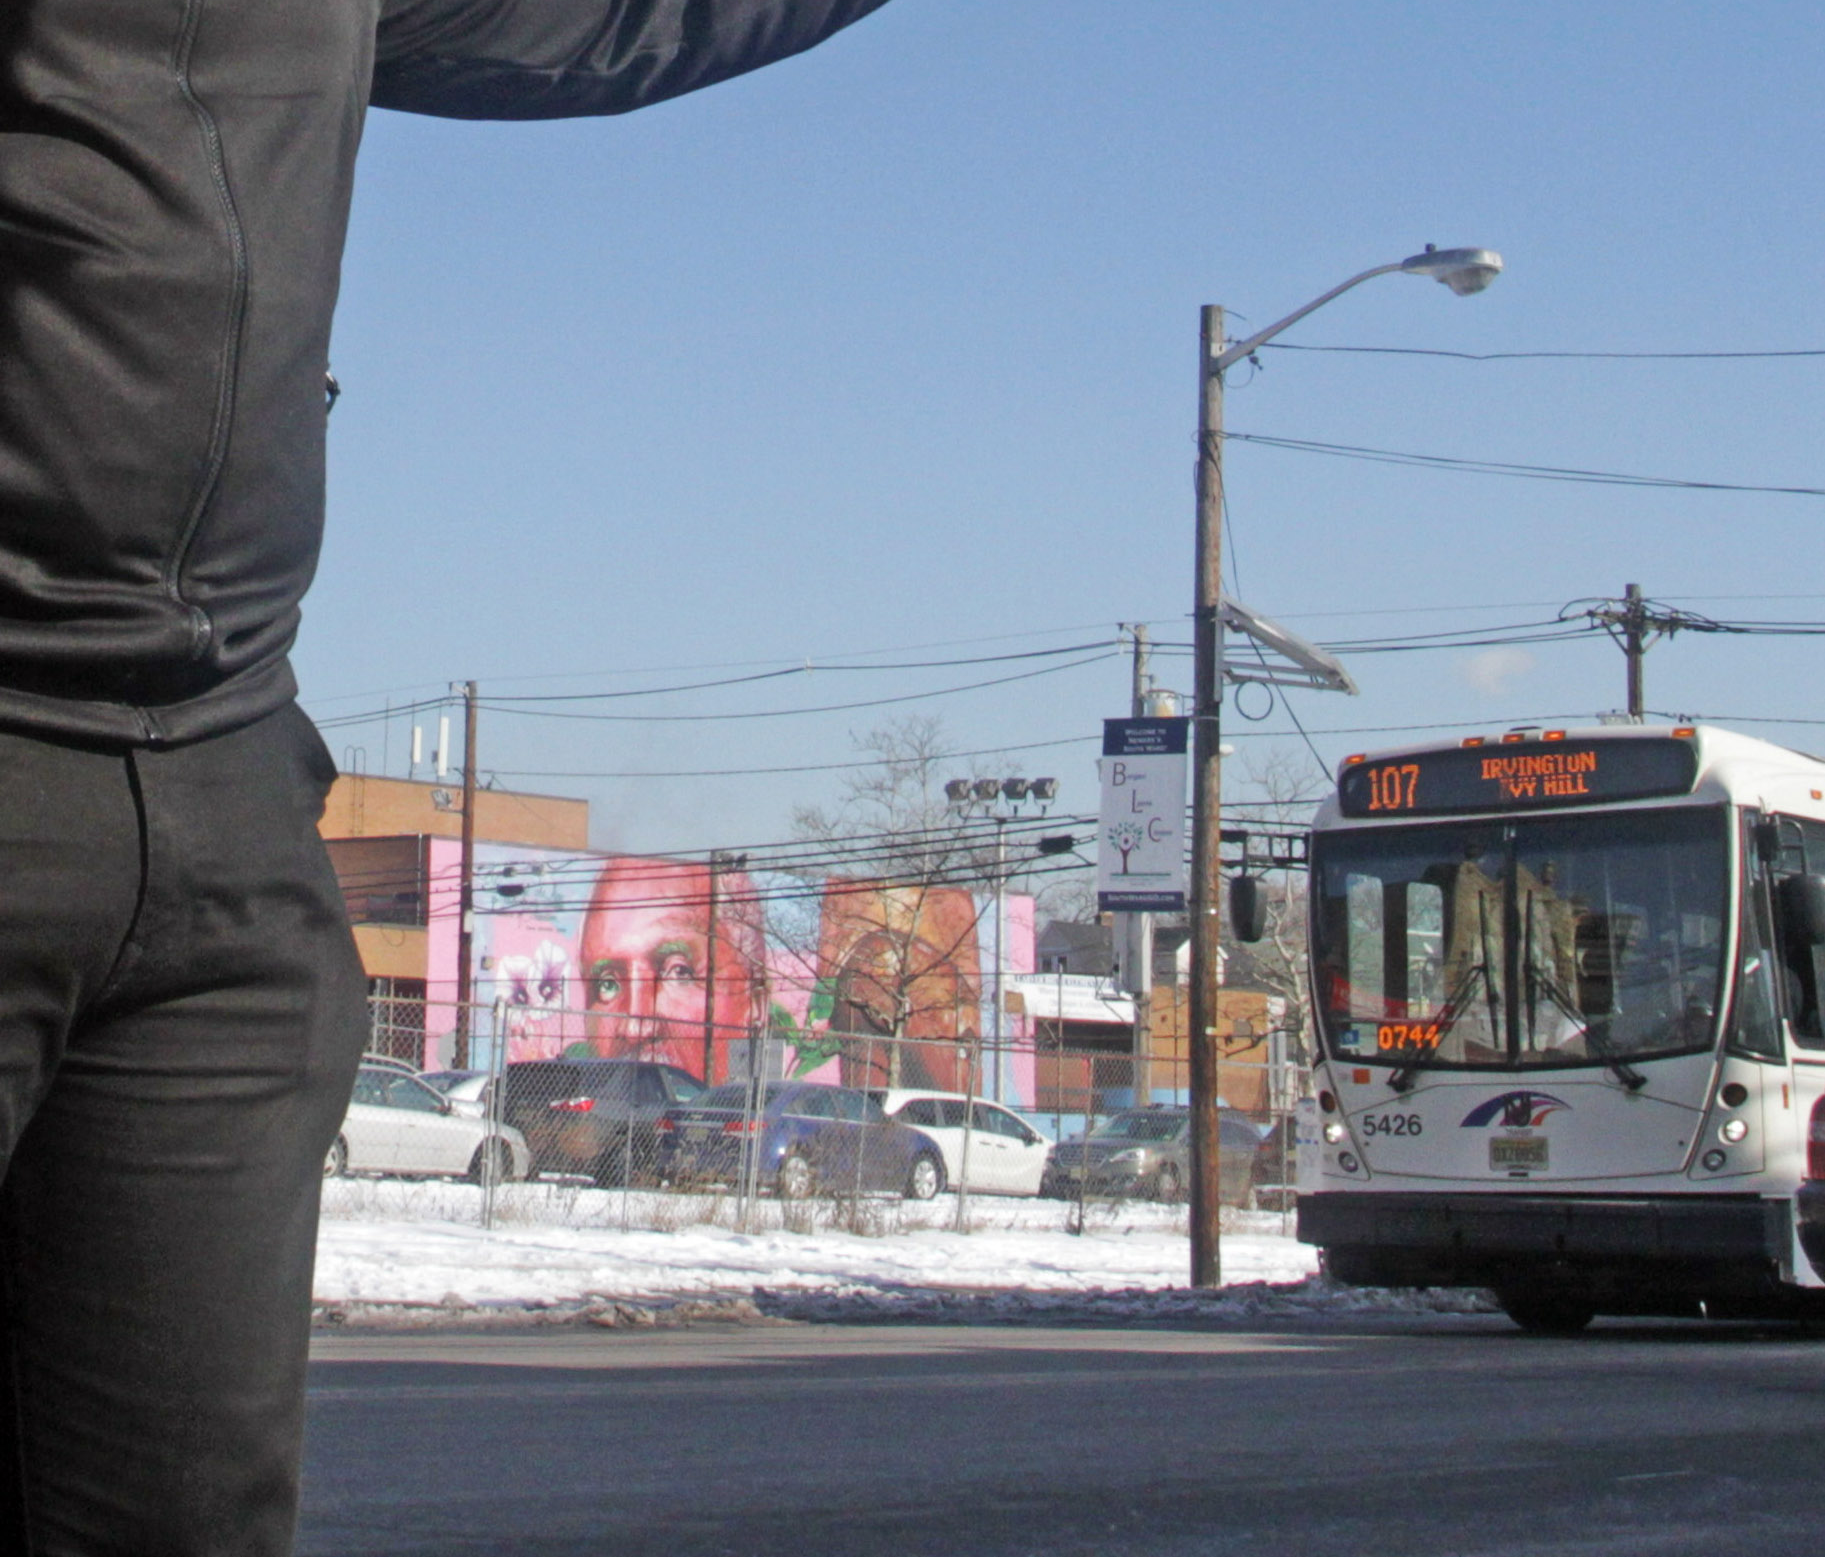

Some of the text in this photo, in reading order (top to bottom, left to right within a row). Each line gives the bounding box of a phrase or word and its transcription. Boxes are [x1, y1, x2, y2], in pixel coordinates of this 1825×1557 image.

[1481, 751, 1597, 781] IRVINGTON
[1367, 764, 1420, 811] 107
[1544, 773, 1589, 796] HILL
[1378, 1024, 1440, 1051] 0744
[1362, 1113, 1423, 1137] 5426
